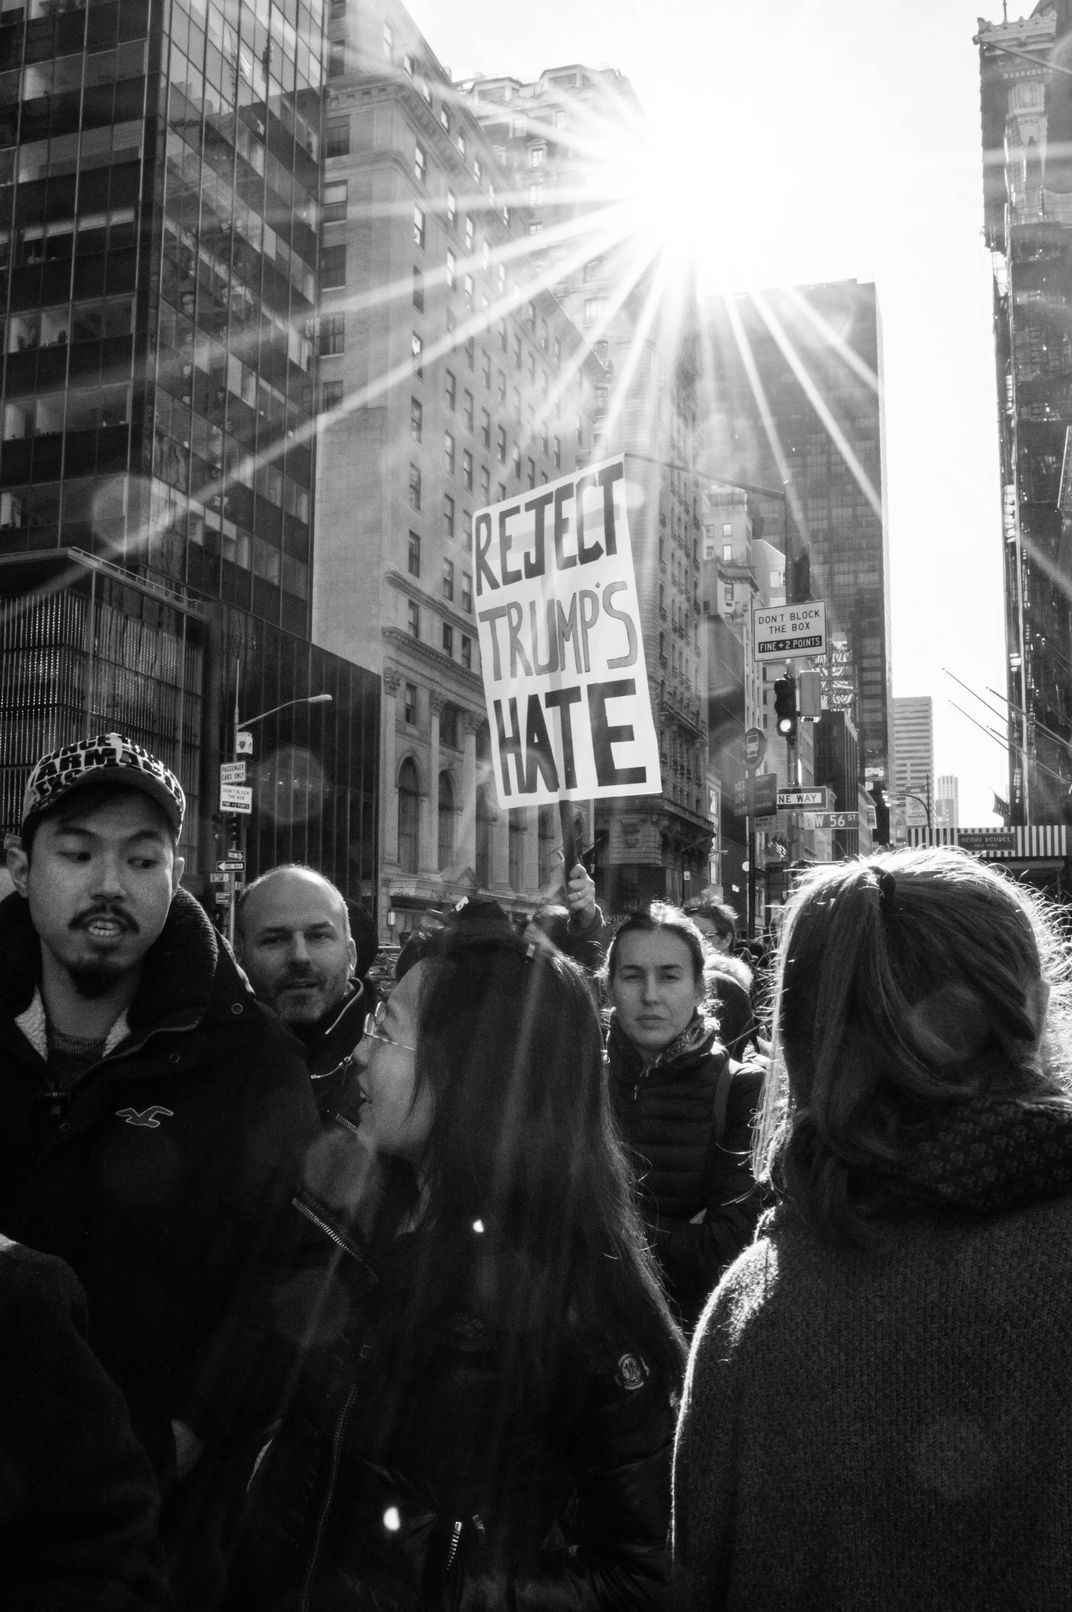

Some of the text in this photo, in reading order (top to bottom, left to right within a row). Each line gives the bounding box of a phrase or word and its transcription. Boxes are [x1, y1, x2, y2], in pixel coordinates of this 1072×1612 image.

[475, 461, 624, 597] REJECT
[789, 609, 820, 621] BLOCK
[478, 580, 638, 681] TRUMP'S
[769, 622, 810, 634] THE BOX
[760, 642, 777, 652] FINE
[785, 640, 790, 649] 2
[792, 637, 821, 649] POINTS
[493, 678, 647, 796] HATE
[776, 794, 817, 803] NE WAY
[814, 814, 824, 828] W
[829, 814, 845, 828] 56
